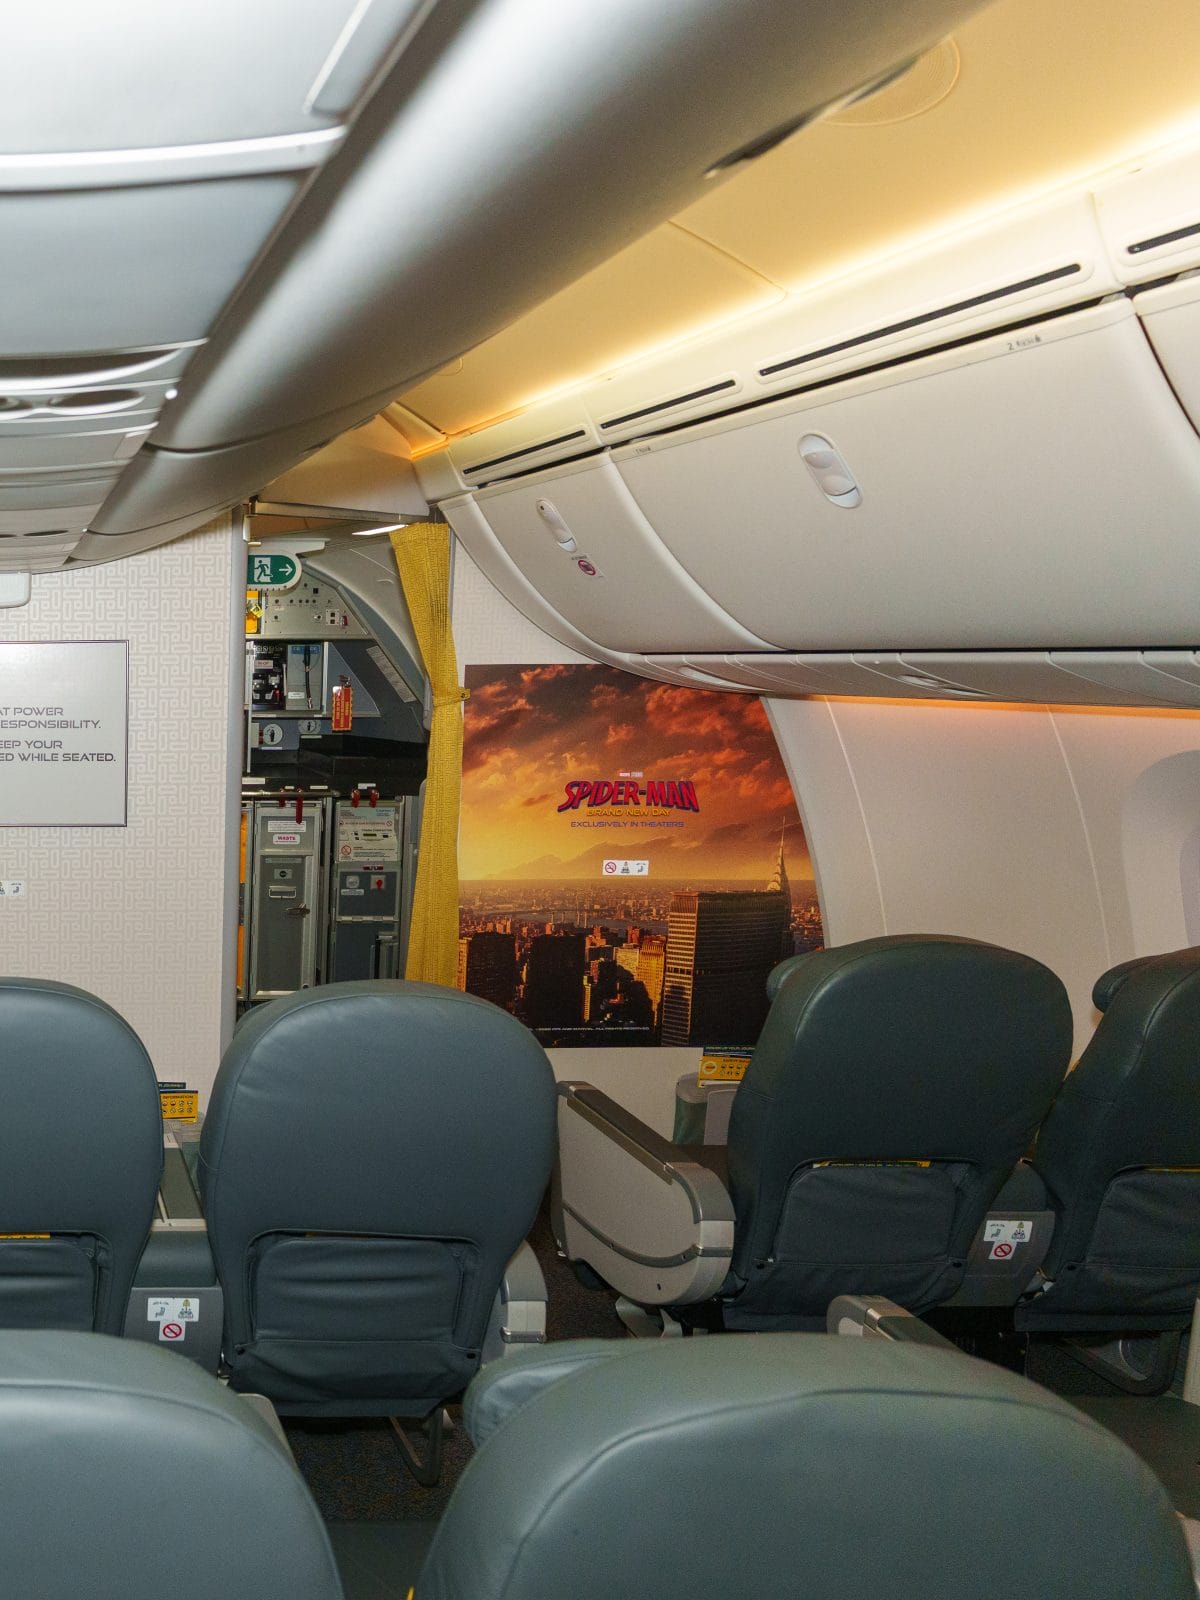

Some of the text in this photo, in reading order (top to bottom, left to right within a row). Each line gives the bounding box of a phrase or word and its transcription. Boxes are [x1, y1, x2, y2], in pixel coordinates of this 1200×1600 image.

[13, 706, 64, 717] POWER
[24, 739, 63, 749] YOUR
[17, 752, 59, 762] WHILE
[61, 752, 117, 762] SEATED.
[557, 780, 700, 813] SPIDER-MAN
[587, 808, 672, 817] BRAND NEW DAY
[570, 820, 685, 828] EXCLUSIVELY IN THEATERS
